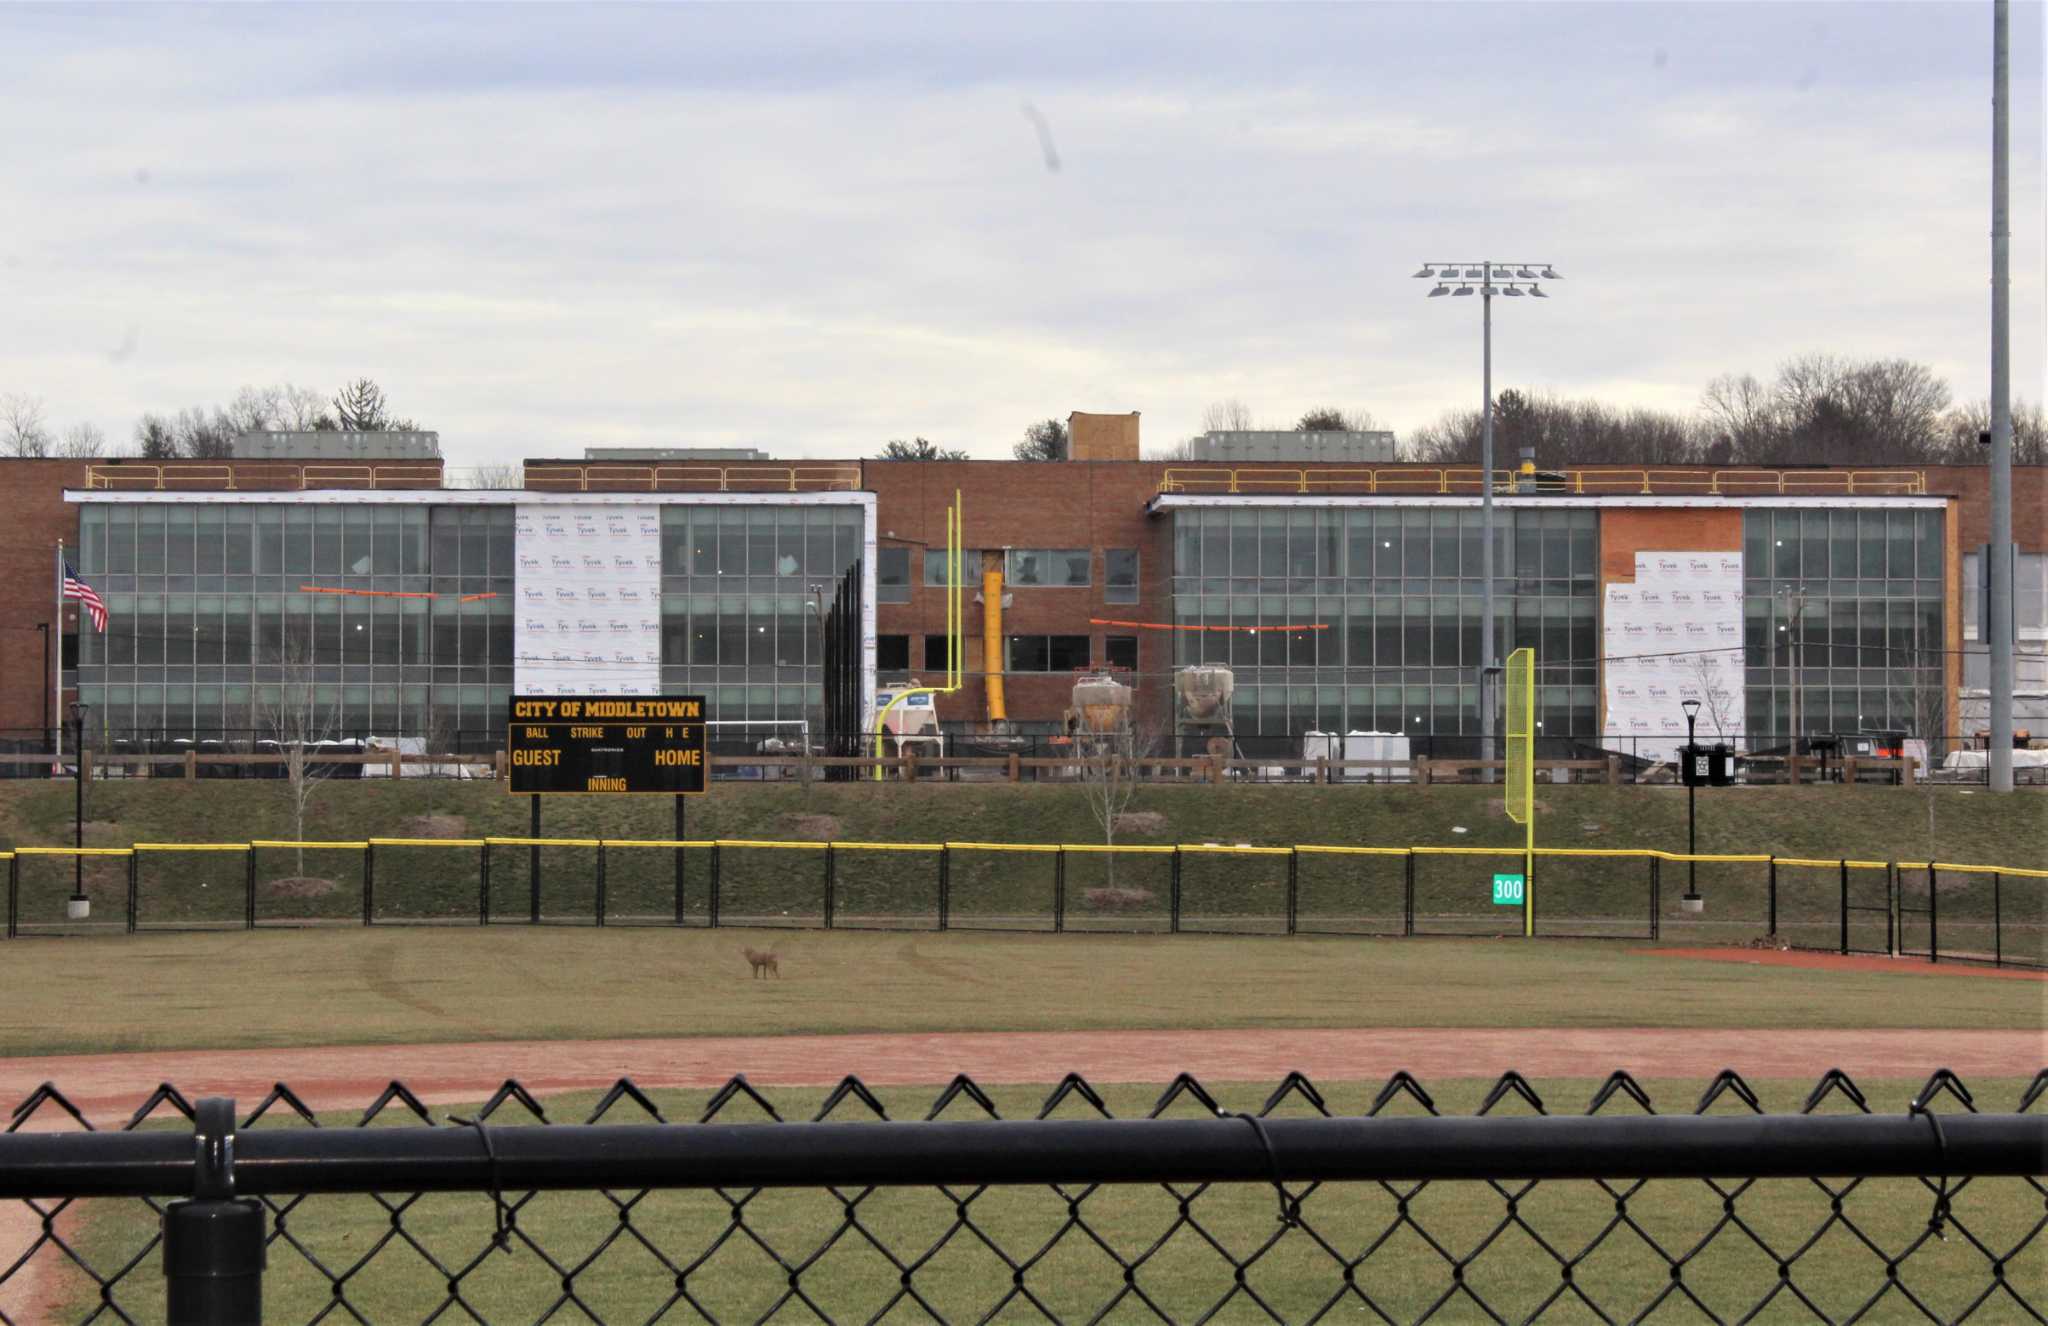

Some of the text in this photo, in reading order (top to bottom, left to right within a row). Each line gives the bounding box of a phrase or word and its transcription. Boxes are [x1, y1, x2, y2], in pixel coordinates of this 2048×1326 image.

[515, 701, 699, 718] CITY OF MIDDLETOWN
[526, 728, 688, 738] BALL STRIKE OUT H E
[513, 750, 700, 766] GUEST HOME
[588, 778, 626, 791] INNING
[1495, 880, 1522, 899] 300
